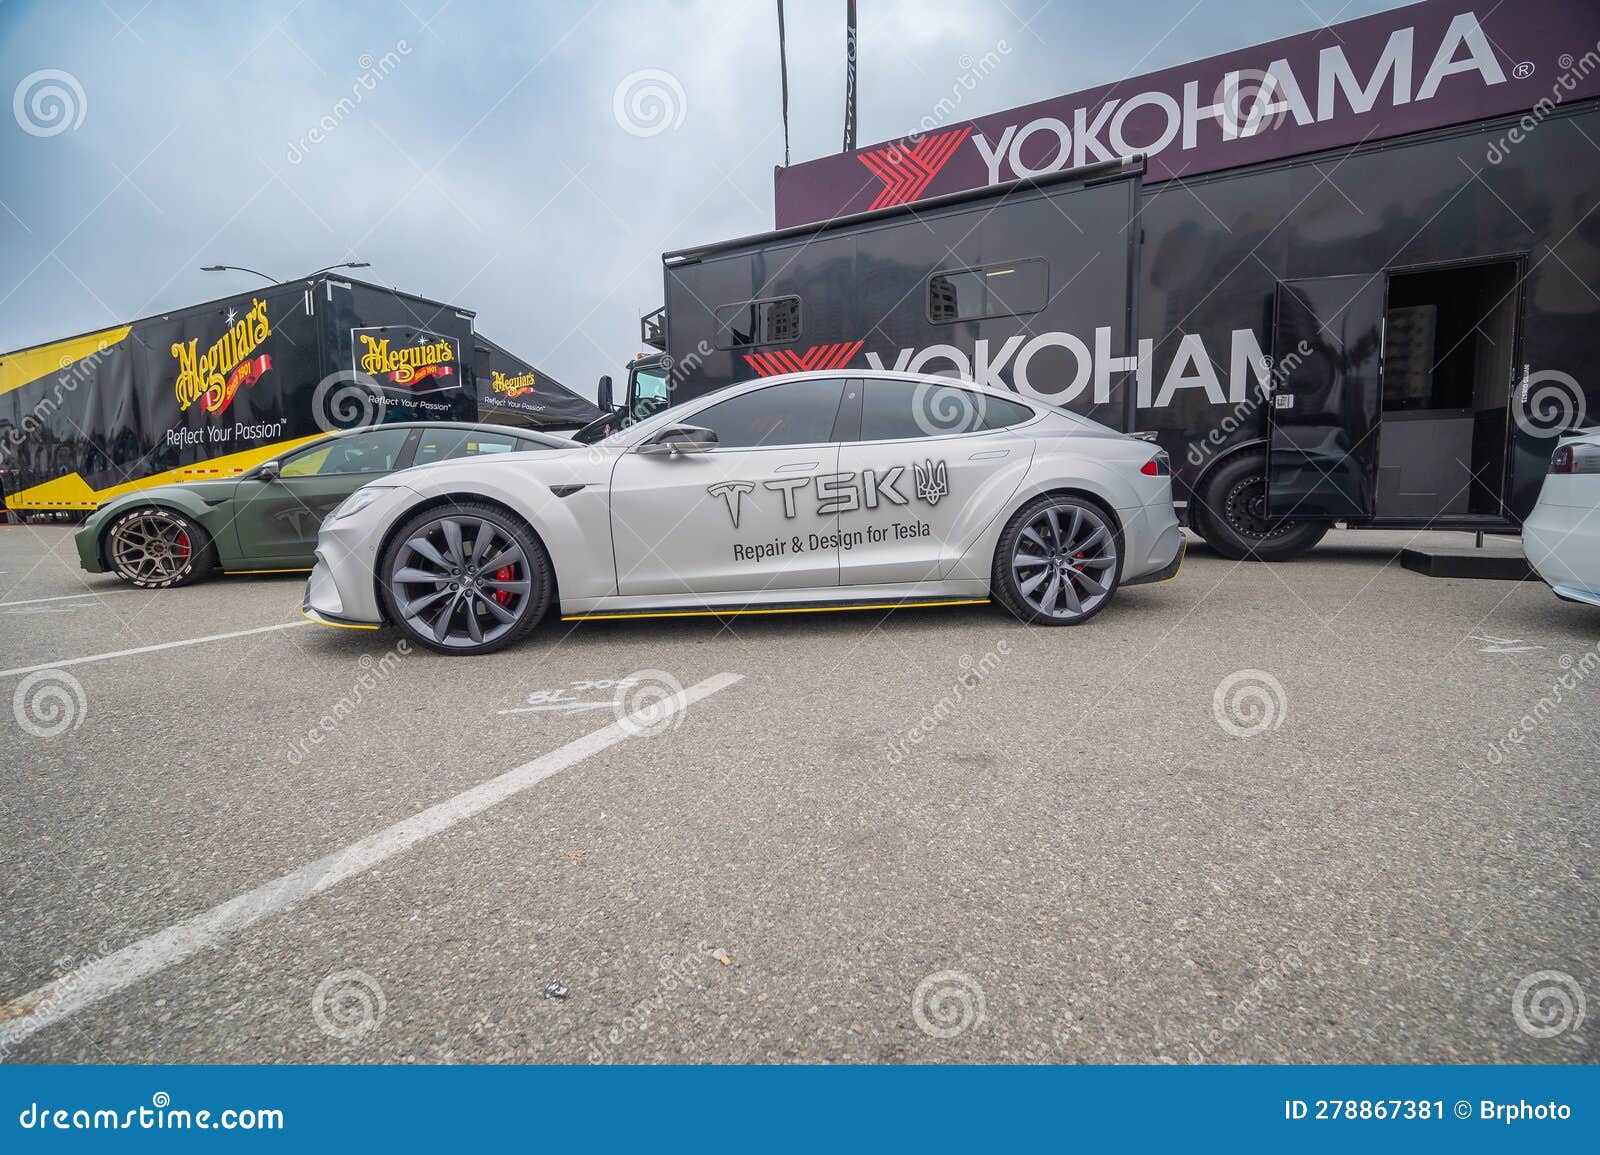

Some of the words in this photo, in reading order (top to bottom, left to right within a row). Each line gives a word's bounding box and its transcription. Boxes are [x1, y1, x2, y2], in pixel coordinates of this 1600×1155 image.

[971, 11, 1508, 186] YOKOHAMA
[171, 297, 272, 411] Meguiar's
[359, 334, 455, 384] Meguiar's
[367, 394, 399, 406] Reflect
[401, 398, 418, 408] Your
[484, 396, 506, 407] Reflect
[507, 400, 521, 409] Your
[166, 426, 204, 450] Reflect
[207, 425, 232, 443] Your
[763, 466, 909, 519] TSK
[733, 537, 788, 562] Repair
[791, 536, 804, 553] &
[808, 529, 863, 551] Design
[866, 526, 889, 543] for
[891, 520, 931, 541] Tesla
